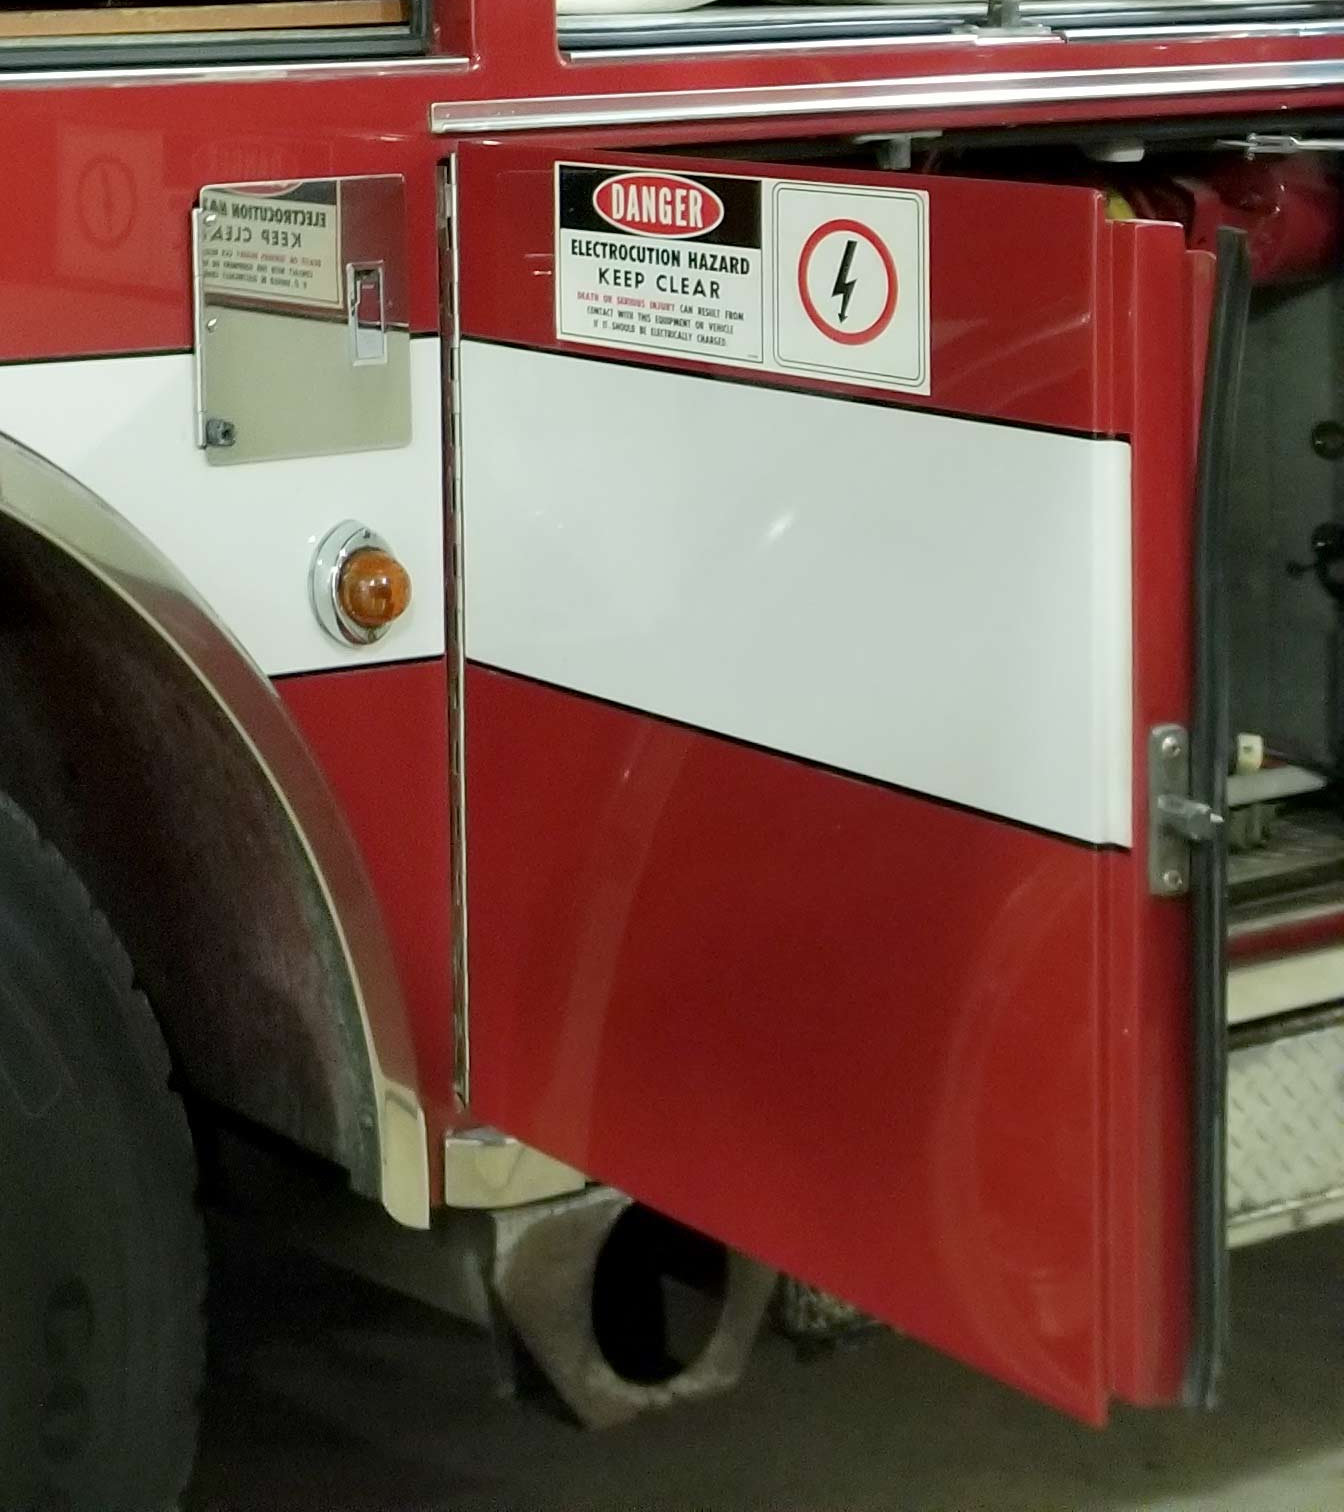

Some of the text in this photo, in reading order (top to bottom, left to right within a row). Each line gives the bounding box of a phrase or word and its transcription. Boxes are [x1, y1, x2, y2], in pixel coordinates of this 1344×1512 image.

[612, 182, 704, 228] DANGER
[570, 238, 750, 275] ELECTROCUTION HAZARD
[598, 266, 720, 299] KEEP CLEAR
[586, 305, 613, 316] CONTACT
[617, 309, 634, 320] WITH
[637, 312, 651, 323] THIS
[655, 314, 691, 329] EQUIPMENT
[708, 321, 734, 335] VEHICLE
[679, 304, 693, 314] CAN
[697, 306, 721, 319] RESULT
[724, 310, 744, 321] FROM
[611, 322, 635, 333] SHOULD
[650, 326, 692, 342] ELECTRICALLY
